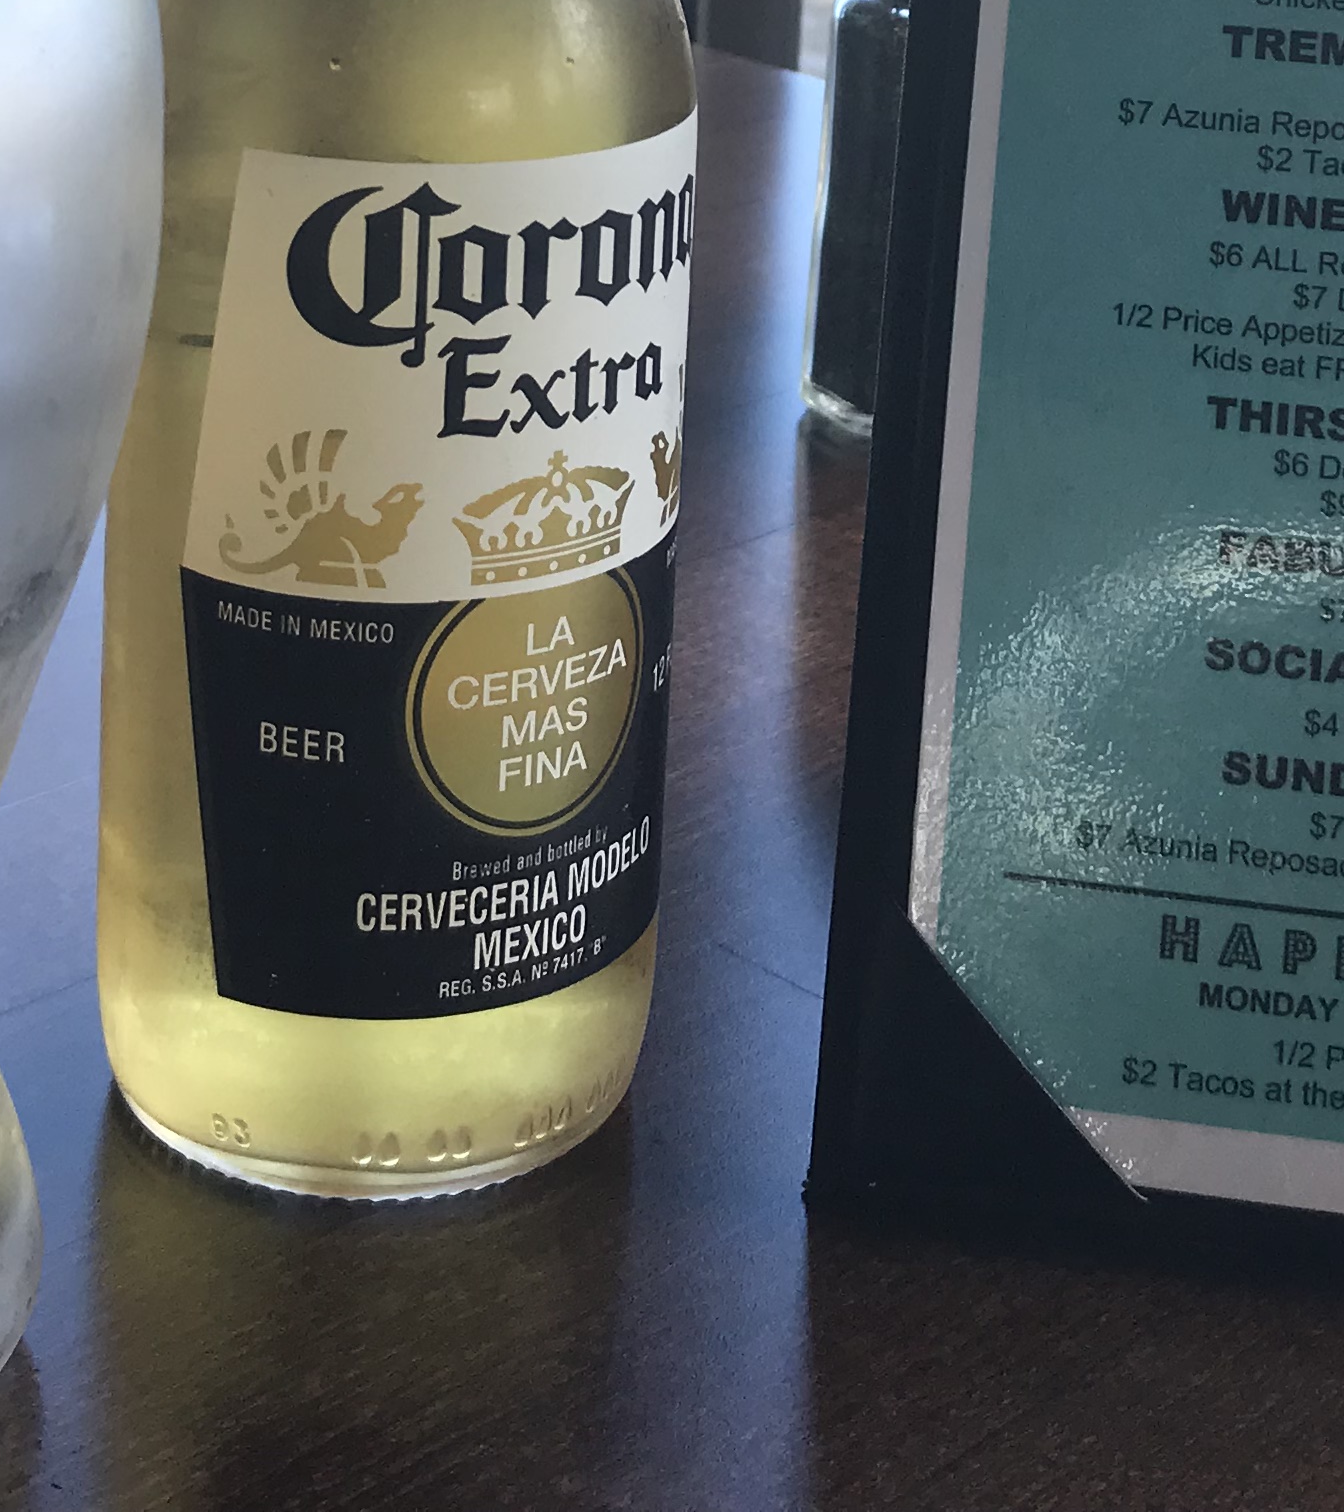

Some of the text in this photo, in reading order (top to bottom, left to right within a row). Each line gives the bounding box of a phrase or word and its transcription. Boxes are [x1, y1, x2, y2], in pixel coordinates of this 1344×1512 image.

[1118, 97, 1152, 125] $7
[1161, 103, 1259, 133] Azunia
[1256, 144, 1292, 173] $2
[286, 174, 694, 367] Corona
[1209, 240, 1243, 268] $6
[1251, 245, 1307, 273] ALL
[1293, 283, 1327, 309] $7
[1113, 302, 1152, 328] 1/2
[1162, 306, 1232, 335] Price
[1192, 343, 1252, 373] Kids
[1261, 355, 1305, 378] eat
[437, 335, 663, 438] Extra
[1273, 448, 1308, 477] $6
[218, 601, 394, 643] MADE IN MEXICO
[527, 616, 574, 655] LA
[448, 638, 626, 710] CERVEZA
[502, 697, 587, 748] MAS
[1304, 708, 1338, 736] $4
[260, 721, 344, 763] BEER
[499, 741, 587, 791] FINA
[1120, 825, 1219, 863] Azunia
[1309, 811, 1344, 840] $7
[453, 824, 608, 880] Brewed and bottled by
[357, 816, 650, 931] CERVECERIA MODELO
[474, 904, 586, 970] MEXICO
[439, 980, 476, 998] REG.
[482, 969, 526, 992] S.S.A.
[1199, 982, 1338, 1022] MONDAY
[1273, 1040, 1315, 1069] 1/2
[1122, 1054, 1156, 1086] $2
[1168, 1062, 1254, 1098] Tacos
[1265, 1078, 1291, 1103] at
